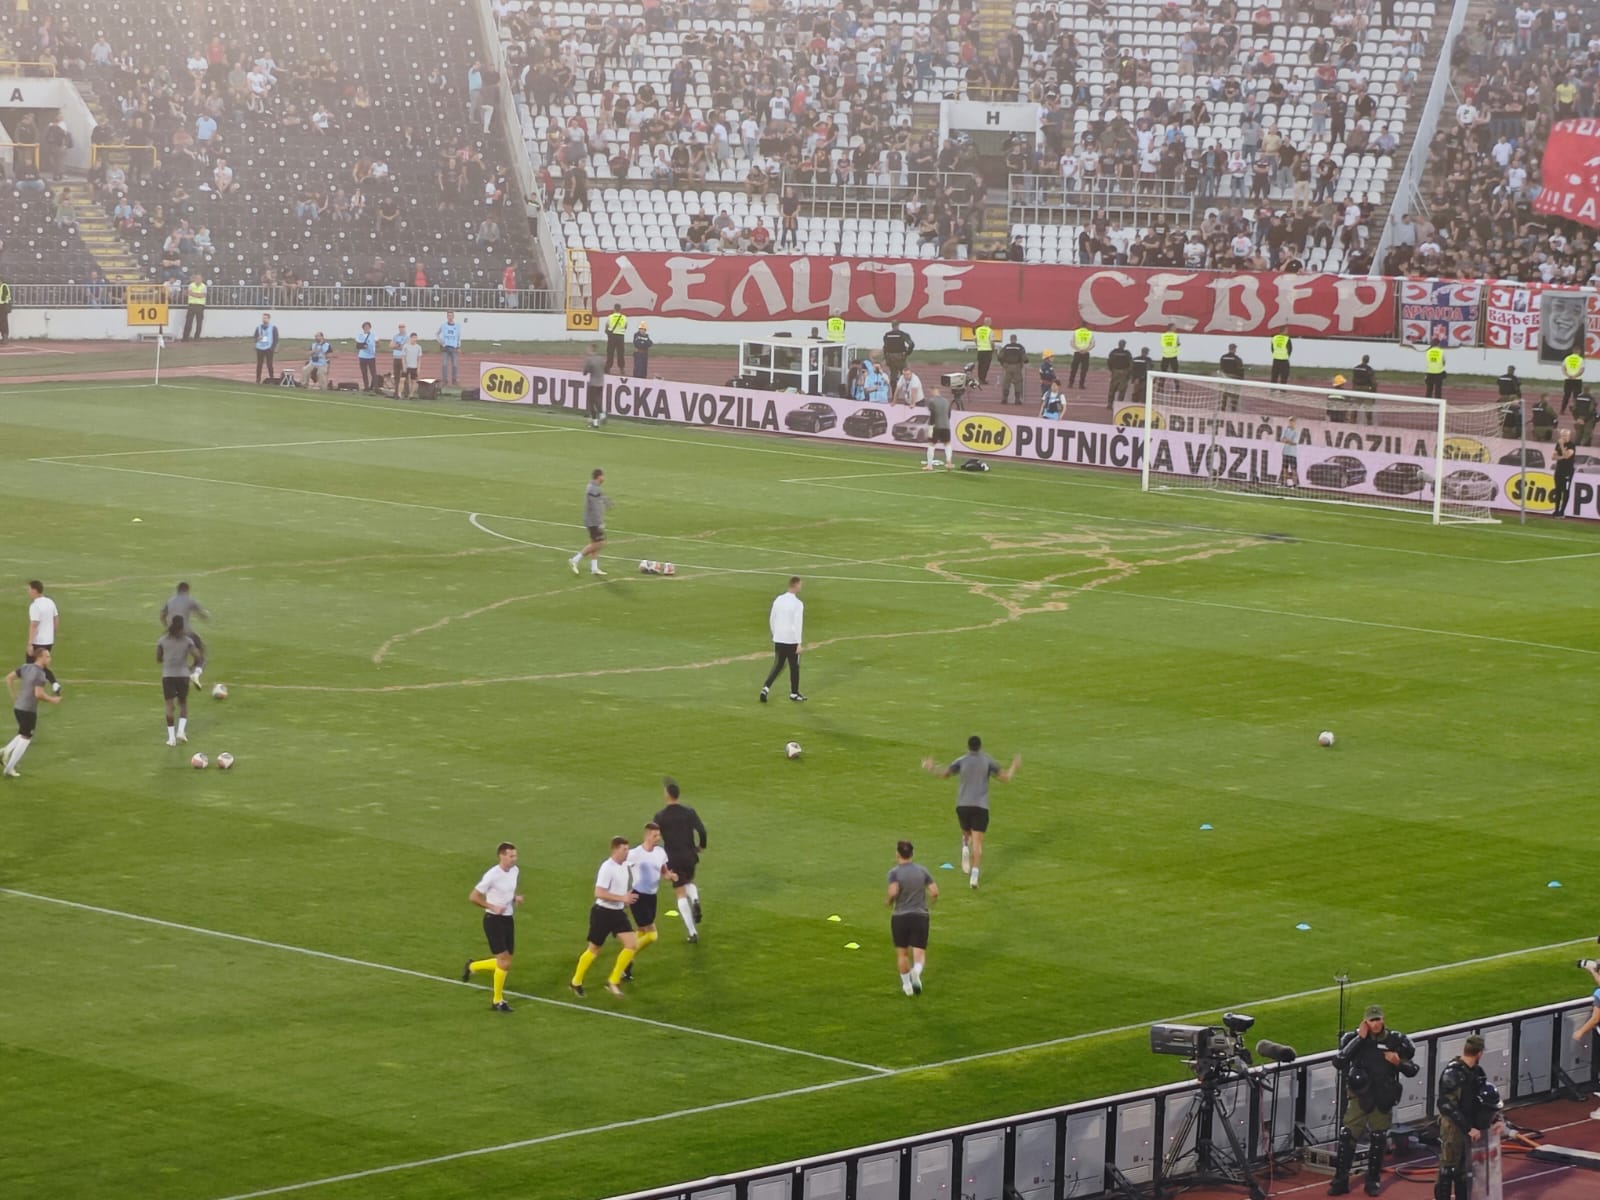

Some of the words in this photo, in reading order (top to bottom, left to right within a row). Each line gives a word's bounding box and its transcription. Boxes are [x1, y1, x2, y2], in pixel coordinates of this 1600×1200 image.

[10, 88, 24, 102] A
[986, 111, 1000, 125] H
[596, 255, 983, 323] ДЕЛИЈЕ
[138, 307, 157, 320] 10
[573, 313, 592, 325] 09
[486, 373, 525, 395] Sind
[532, 376, 671, 419] PUTIČKA
[681, 391, 779, 430] VOZILA
[962, 423, 1005, 446] Sind
[1015, 424, 1174, 472] PUTNIČKA
[1573, 482, 1600, 516] P
